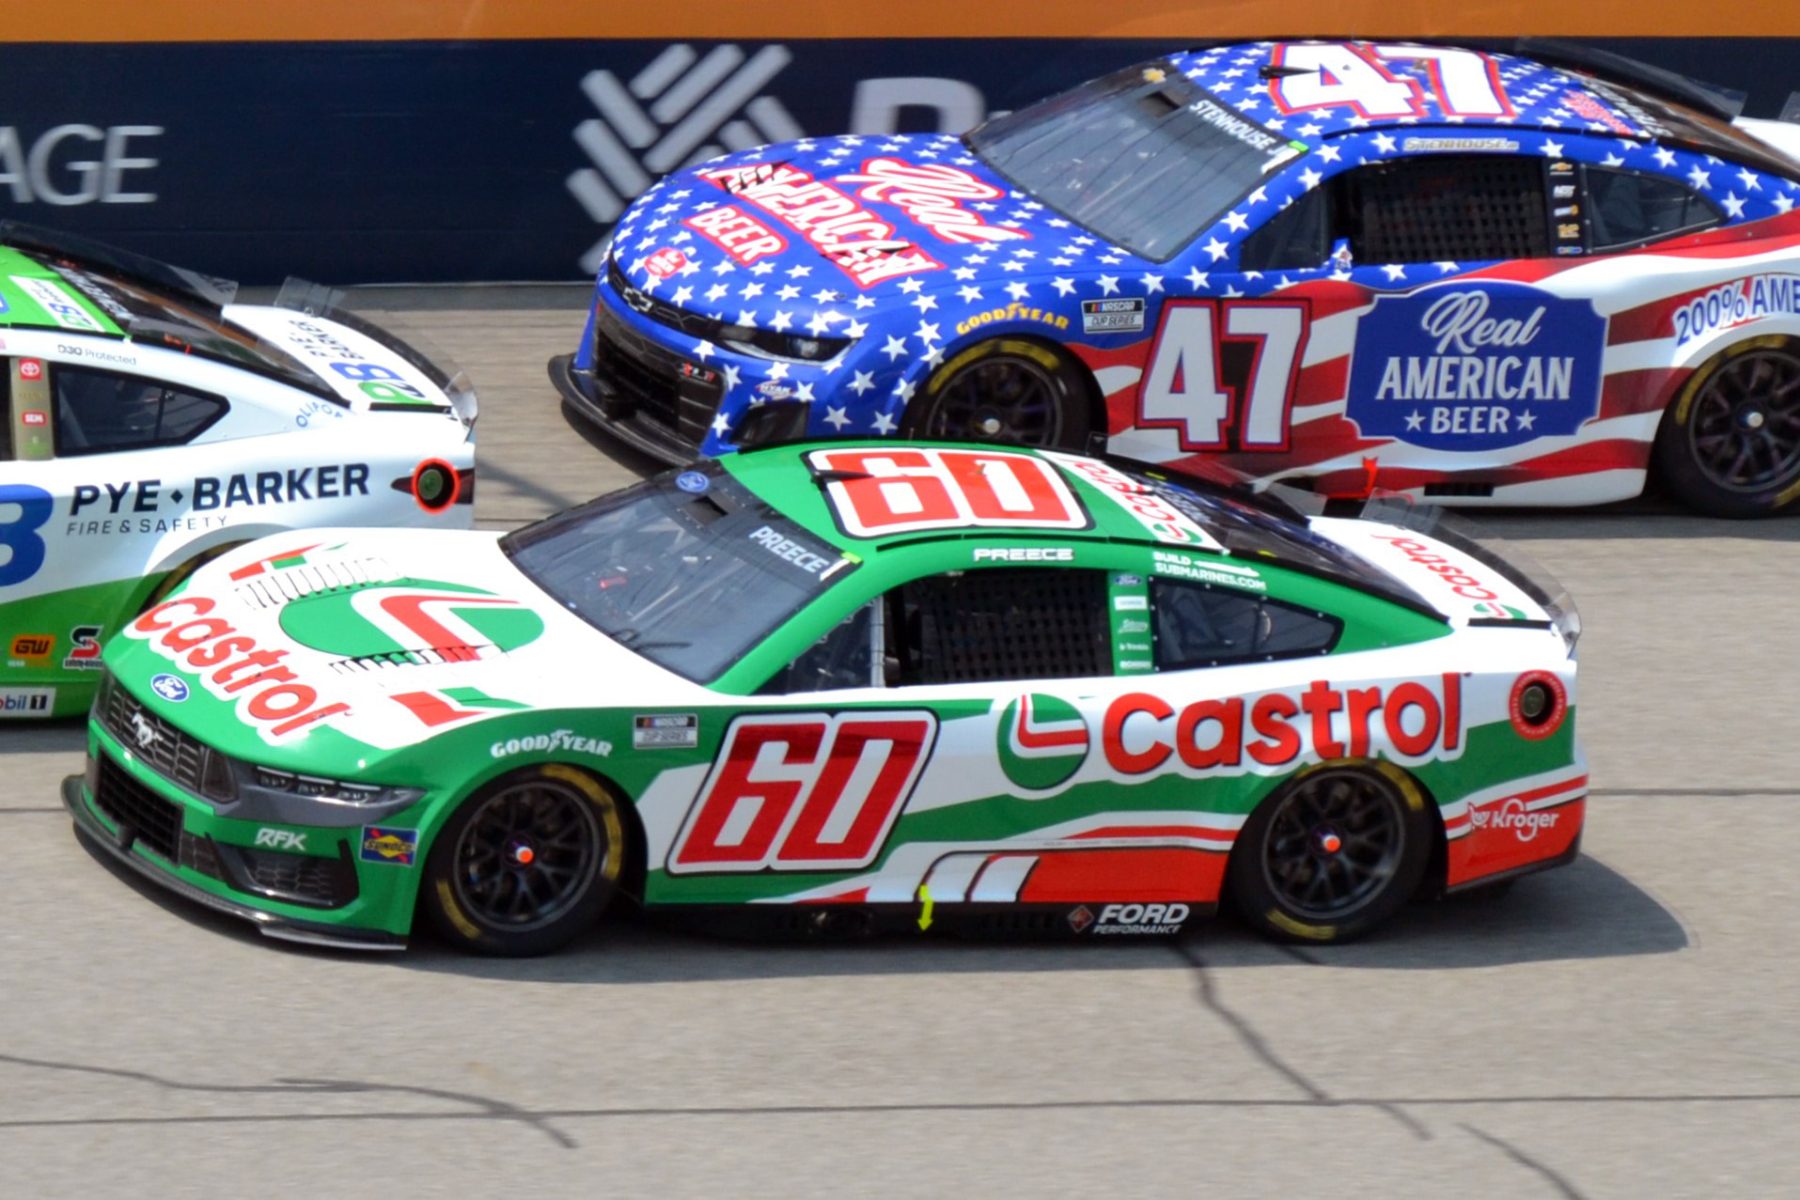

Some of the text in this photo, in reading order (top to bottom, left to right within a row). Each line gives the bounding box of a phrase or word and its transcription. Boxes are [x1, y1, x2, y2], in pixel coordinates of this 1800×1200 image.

[1269, 43, 1517, 119] 47
[1190, 99, 1277, 150] STENHOUSE
[832, 158, 1034, 244] Real
[683, 206, 788, 265] BEER
[956, 301, 1069, 335] GOODYEAR
[1421, 290, 1547, 355] Real
[1677, 280, 1745, 346] 200%
[1138, 302, 1310, 449] 47
[1376, 355, 1575, 400] AMERICAN
[1429, 406, 1509, 434] BEER
[69, 463, 371, 516] PYE BARKER
[820, 450, 1078, 532] 60
[66, 515, 228, 536] FIRE & SAFETY
[749, 526, 830, 575] PREECE
[973, 547, 1074, 562] PREECE
[1153, 551, 1191, 566] BUILD
[1154, 562, 1267, 591] SUBMARINES.COM
[1371, 533, 1498, 601] Castrol
[134, 596, 352, 737] Castrol
[490, 729, 613, 758] GOODYEAR
[1102, 672, 1461, 774] Castrol
[672, 718, 932, 866] 60
[255, 827, 308, 850] RFK
[1093, 924, 1182, 934] PERFORMANCE
[1098, 903, 1190, 924] FORD
